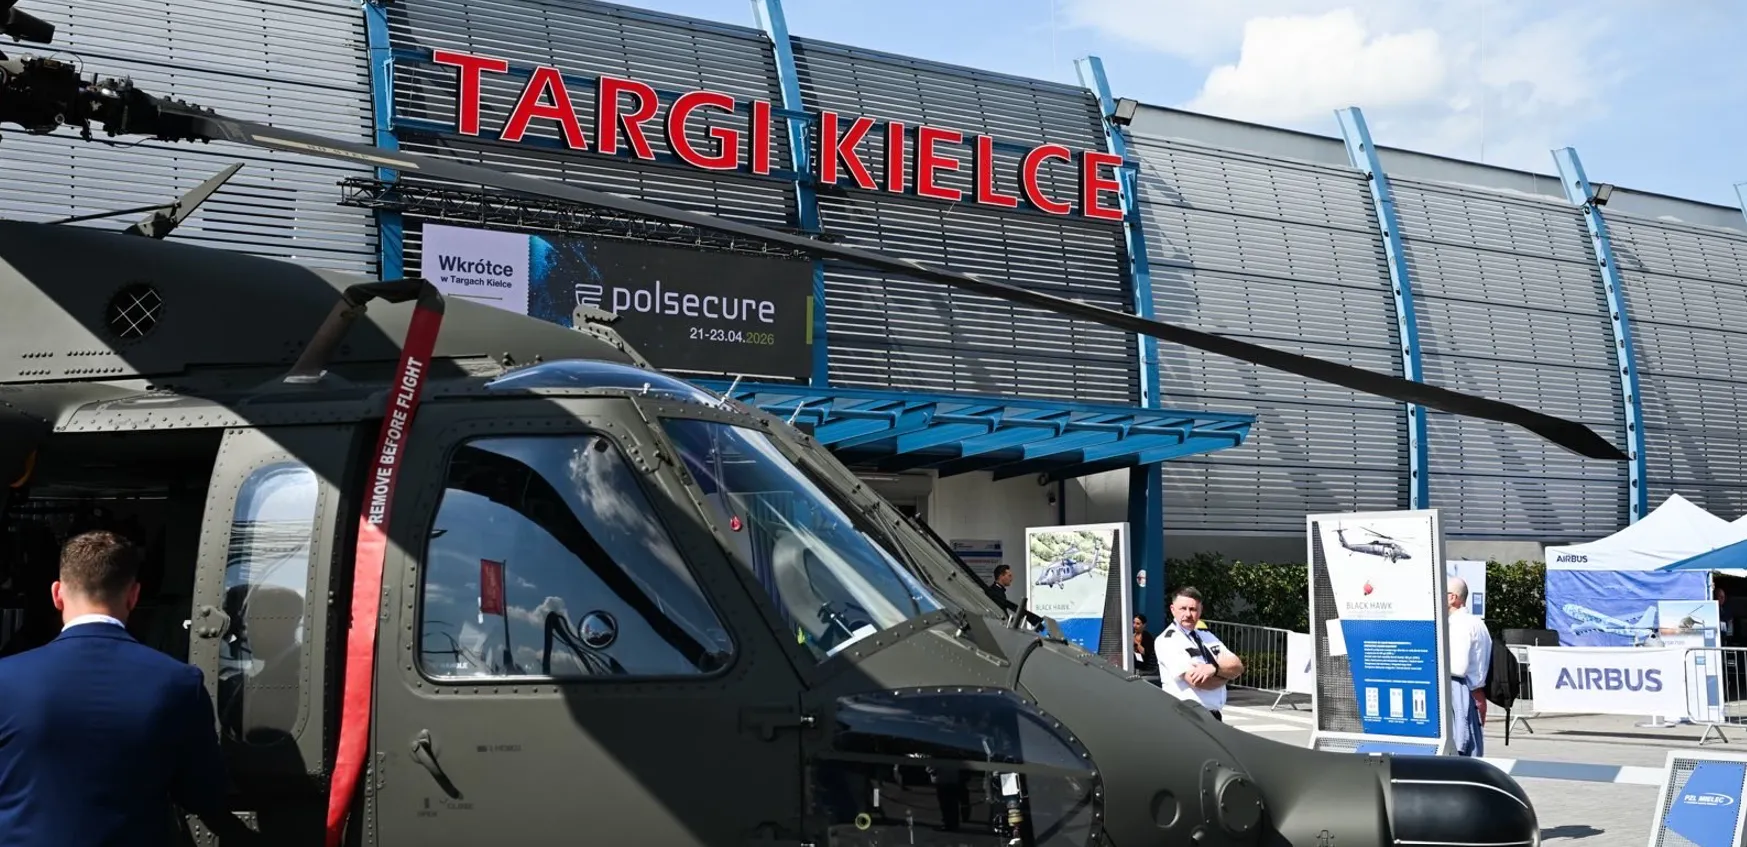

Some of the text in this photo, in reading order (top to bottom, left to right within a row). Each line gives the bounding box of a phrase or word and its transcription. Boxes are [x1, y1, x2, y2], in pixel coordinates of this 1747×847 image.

[433, 50, 1125, 221] TARGI KIELCE
[438, 254, 514, 278] Wkrótce
[440, 275, 512, 288] w Targach Kielce
[612, 280, 776, 323] polsecure
[689, 327, 775, 346] 21-23.04.2026
[368, 356, 424, 525] REMOVE BEFORE FLIGHT
[1556, 554, 1588, 563] AIRBUS
[1346, 602, 1392, 610] BLACK HAWK
[1555, 667, 1663, 693] AIRBUS
